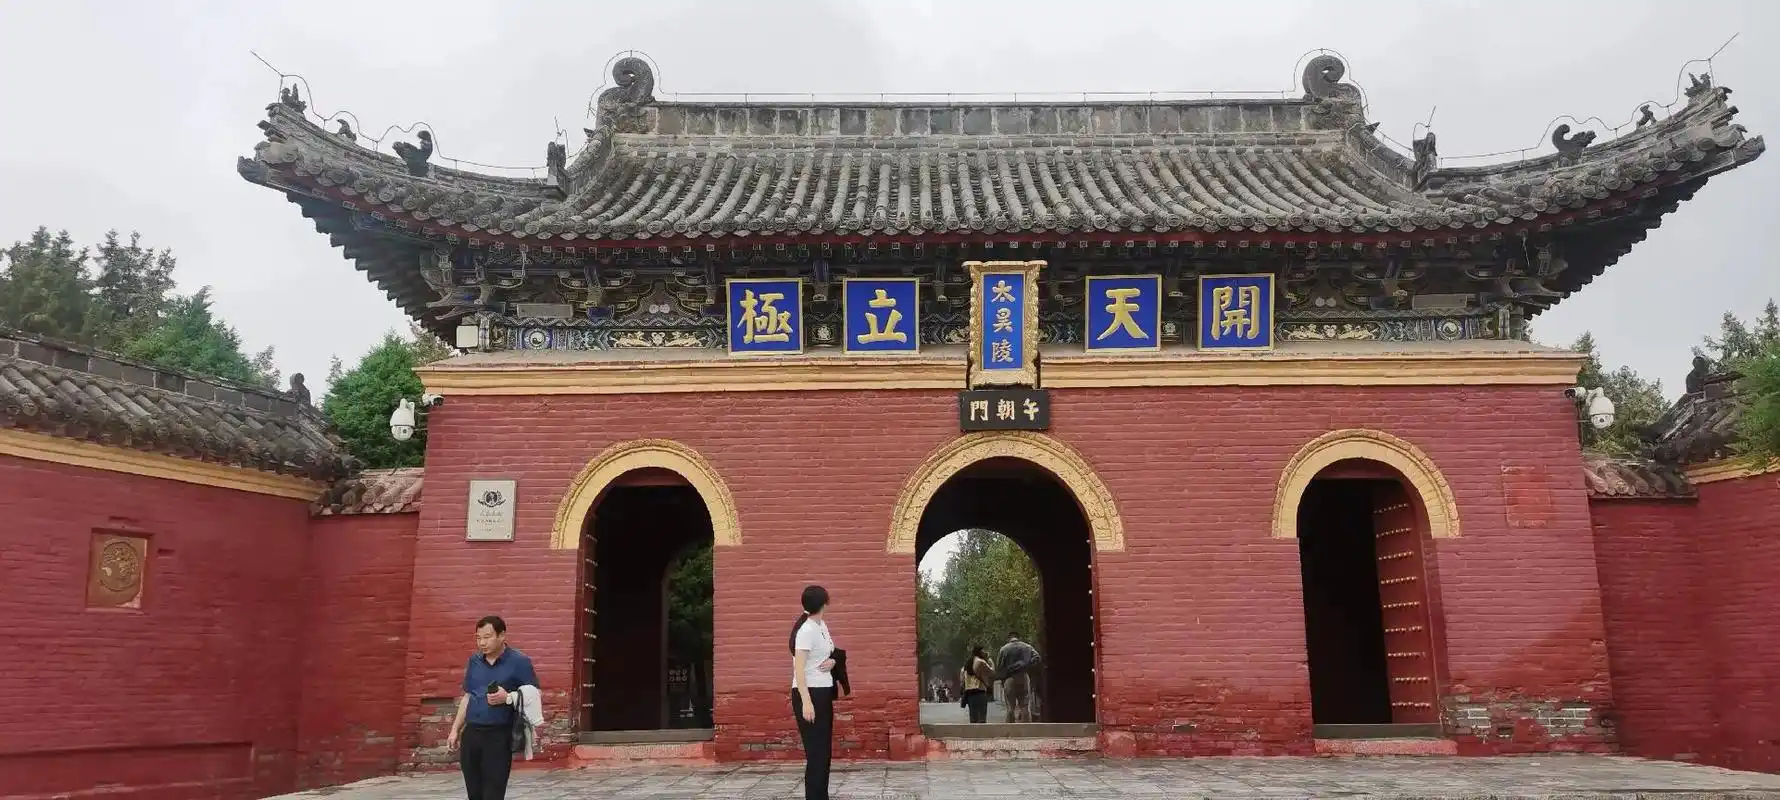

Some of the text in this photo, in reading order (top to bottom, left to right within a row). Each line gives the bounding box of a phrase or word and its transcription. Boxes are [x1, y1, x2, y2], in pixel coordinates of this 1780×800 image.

[737, 289, 793, 344] 極
[857, 289, 907, 344] 立
[1096, 287, 1149, 341] 天
[1211, 285, 1260, 341] 開
